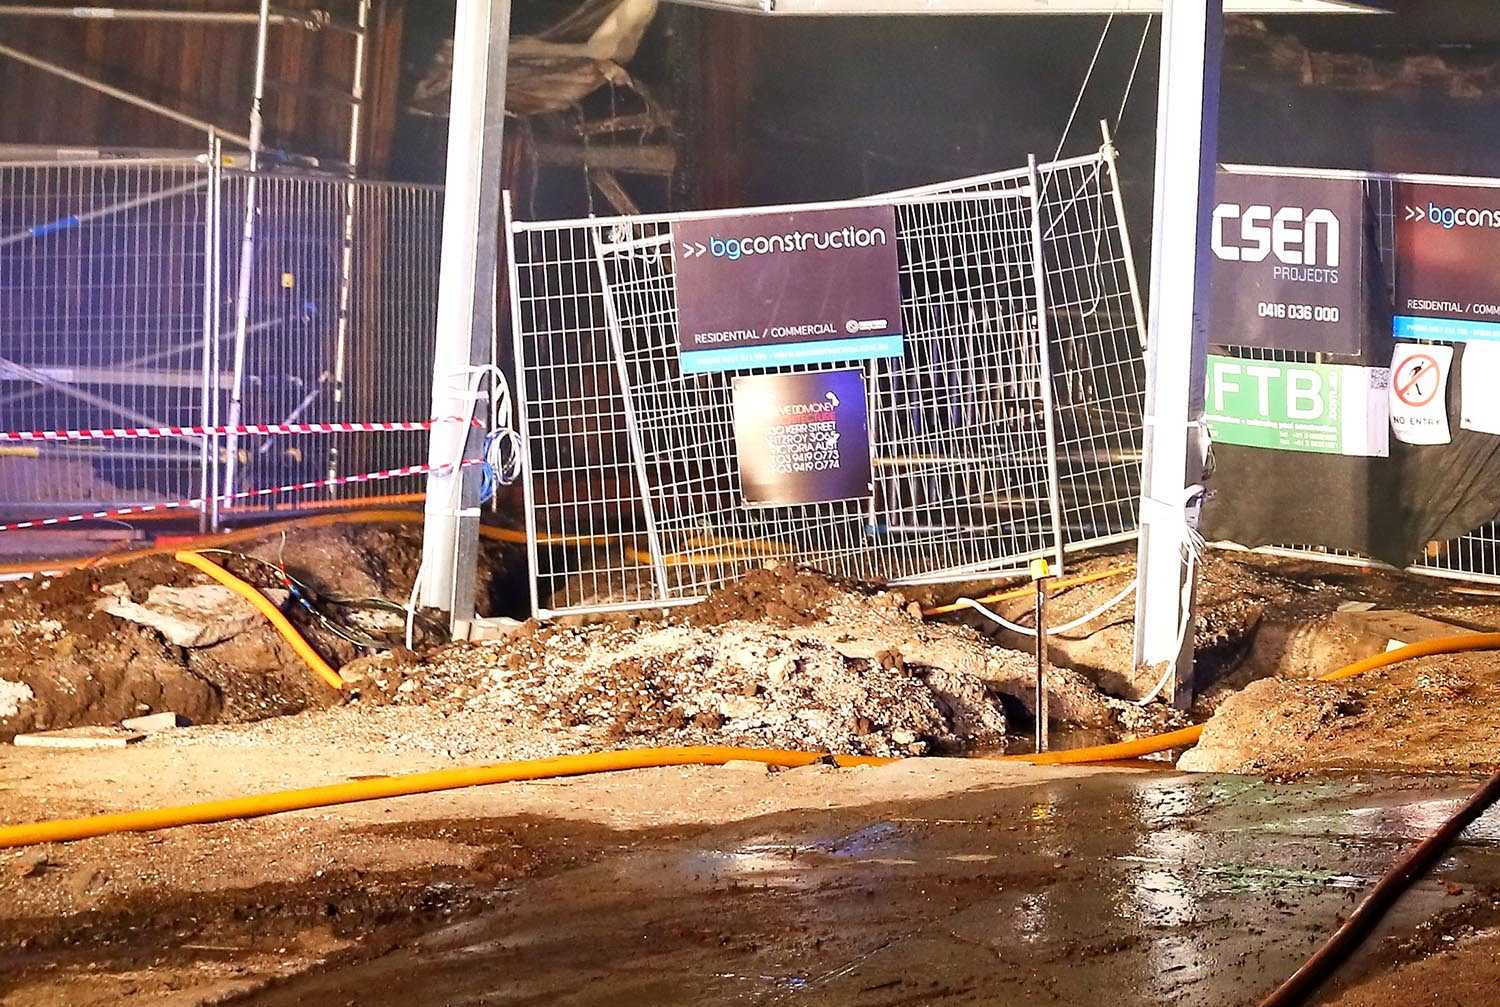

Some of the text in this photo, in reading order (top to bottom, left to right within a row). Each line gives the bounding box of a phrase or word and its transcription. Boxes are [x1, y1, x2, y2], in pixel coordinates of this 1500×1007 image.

[710, 226, 886, 260] bgconstruction
[1273, 266, 1339, 284] PROJECTS
[1258, 302, 1339, 323] 0416 036 000
[1407, 299, 1463, 313] RESIDENTIAL
[694, 328, 760, 344] RESIDENTIAL
[771, 323, 837, 339] COMMERCIAL
[808, 421, 836, 432] STREET
[1393, 416, 1441, 425] NO ENTRY
[814, 449, 840, 460] 0773
[814, 459, 840, 470] 0774
